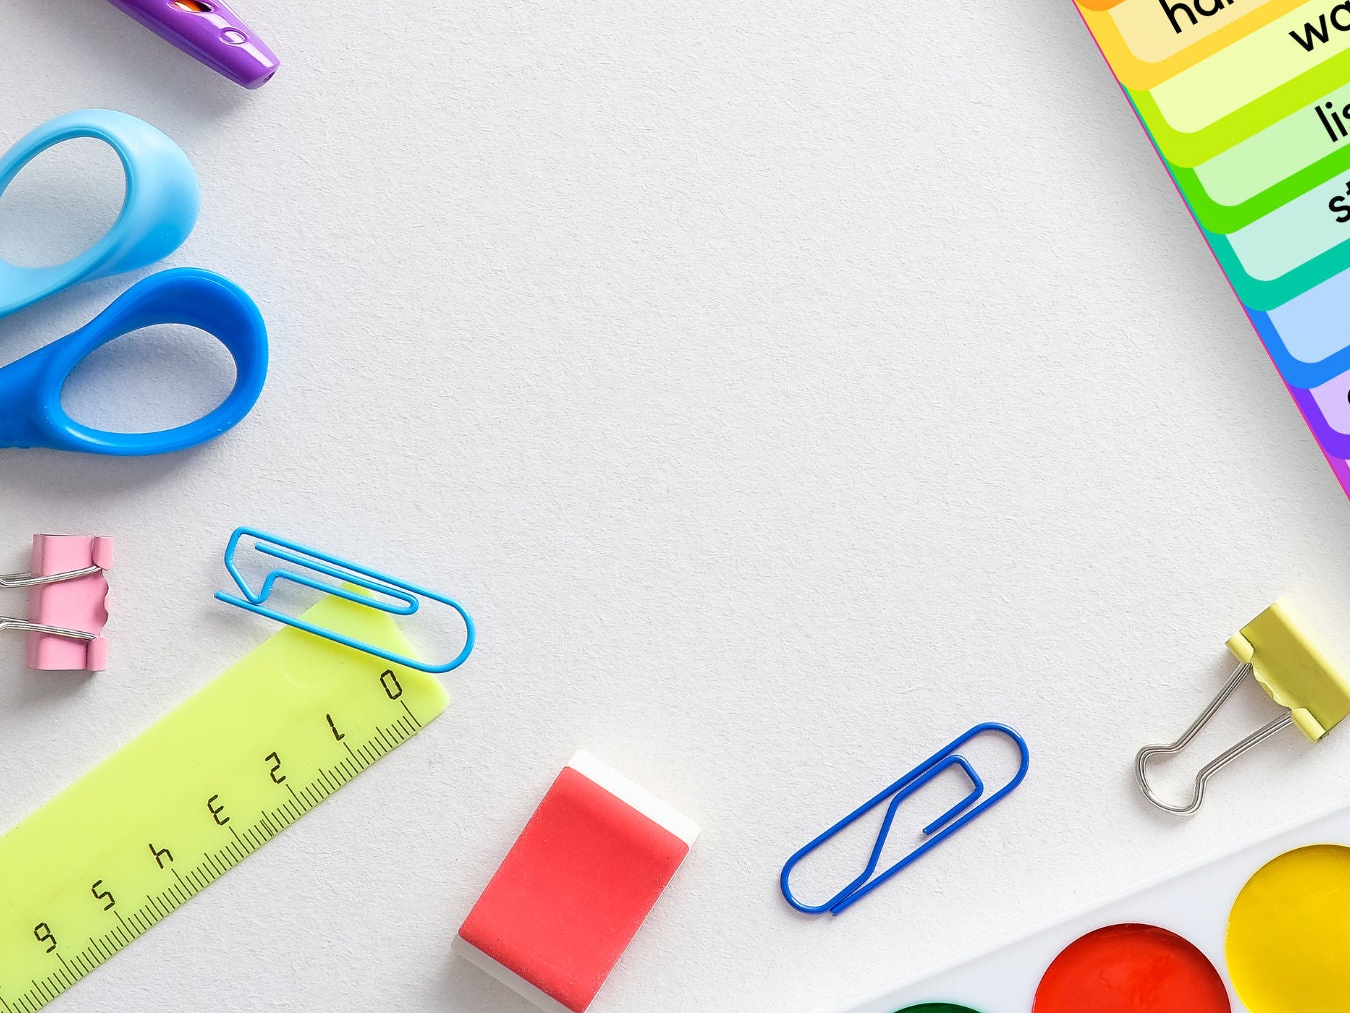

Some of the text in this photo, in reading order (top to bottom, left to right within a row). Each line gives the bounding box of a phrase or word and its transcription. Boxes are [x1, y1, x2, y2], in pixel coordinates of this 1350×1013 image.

[33, 669, 403, 953] 0 1 2 3 4 5 6
